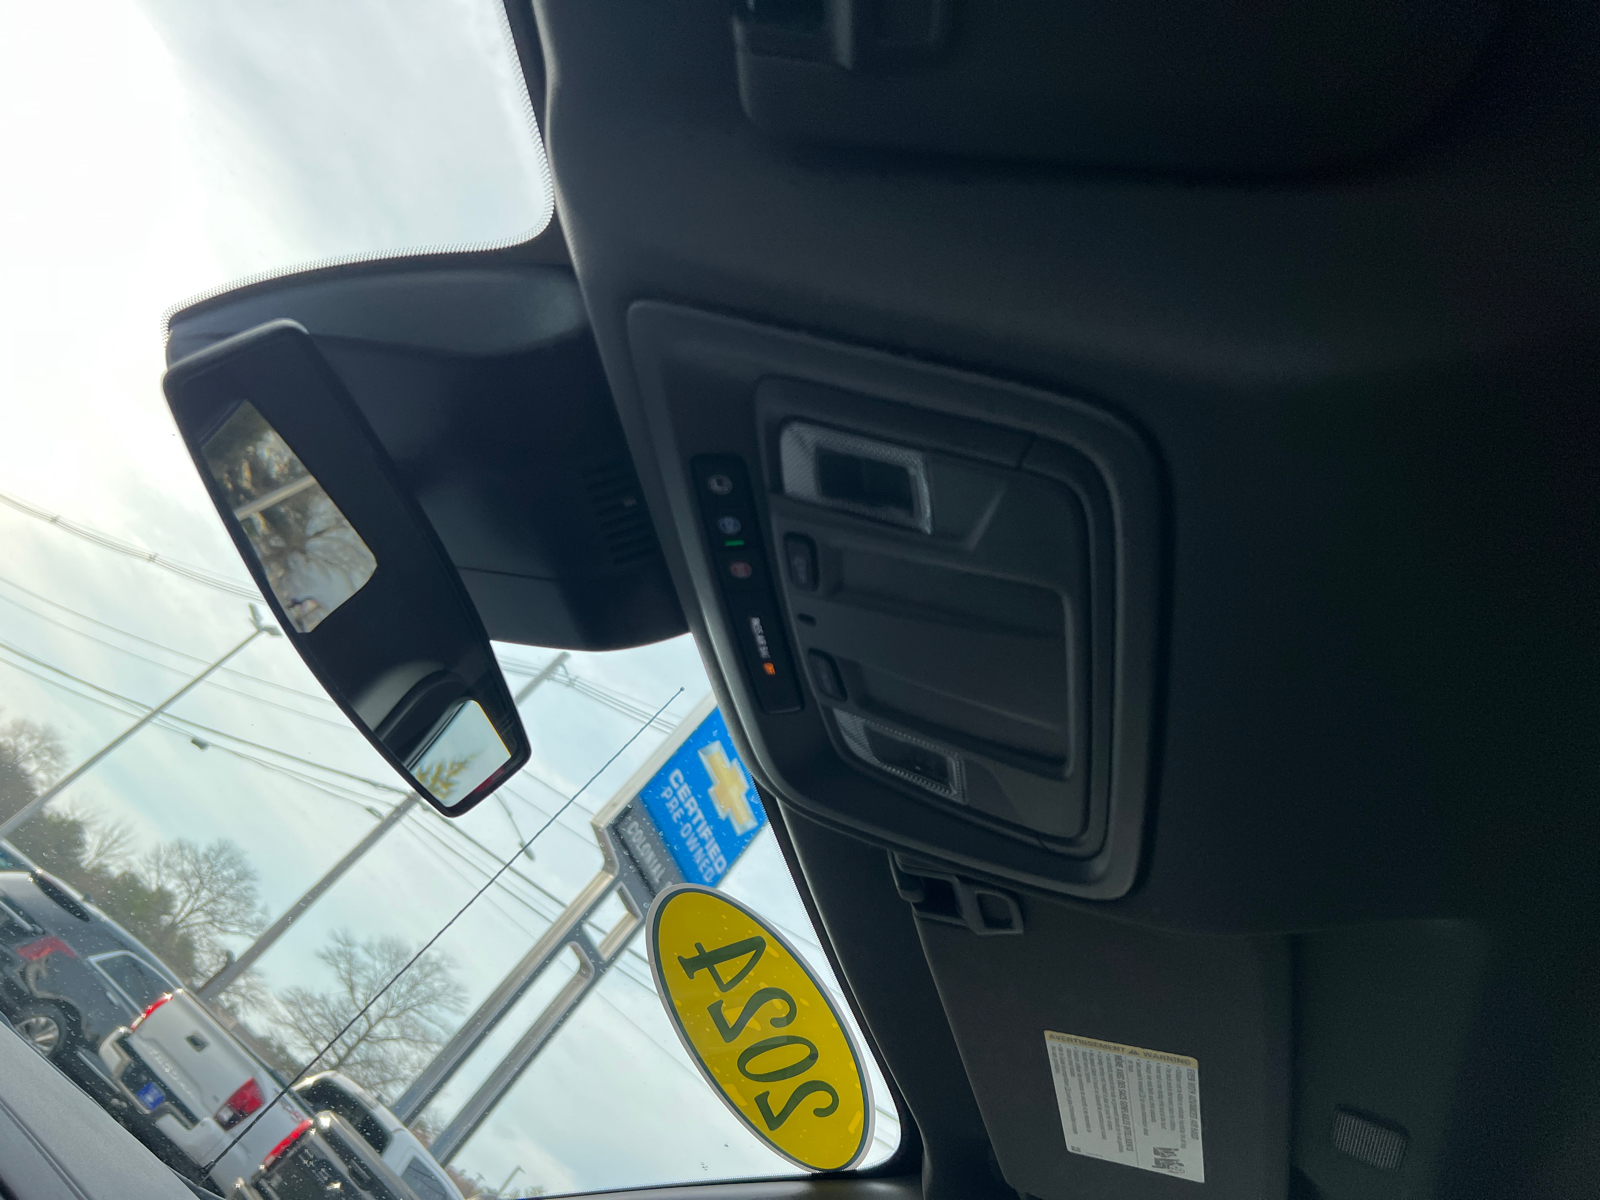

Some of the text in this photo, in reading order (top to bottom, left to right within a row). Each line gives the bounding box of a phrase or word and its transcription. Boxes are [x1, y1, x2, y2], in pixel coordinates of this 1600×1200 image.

[626, 821, 666, 881] COLONIAL
[661, 787, 715, 883] PRE-OWNED
[668, 768, 727, 874] CERTIFIED
[1049, 1034, 1191, 1065] AVERTISSEMENT WARNING
